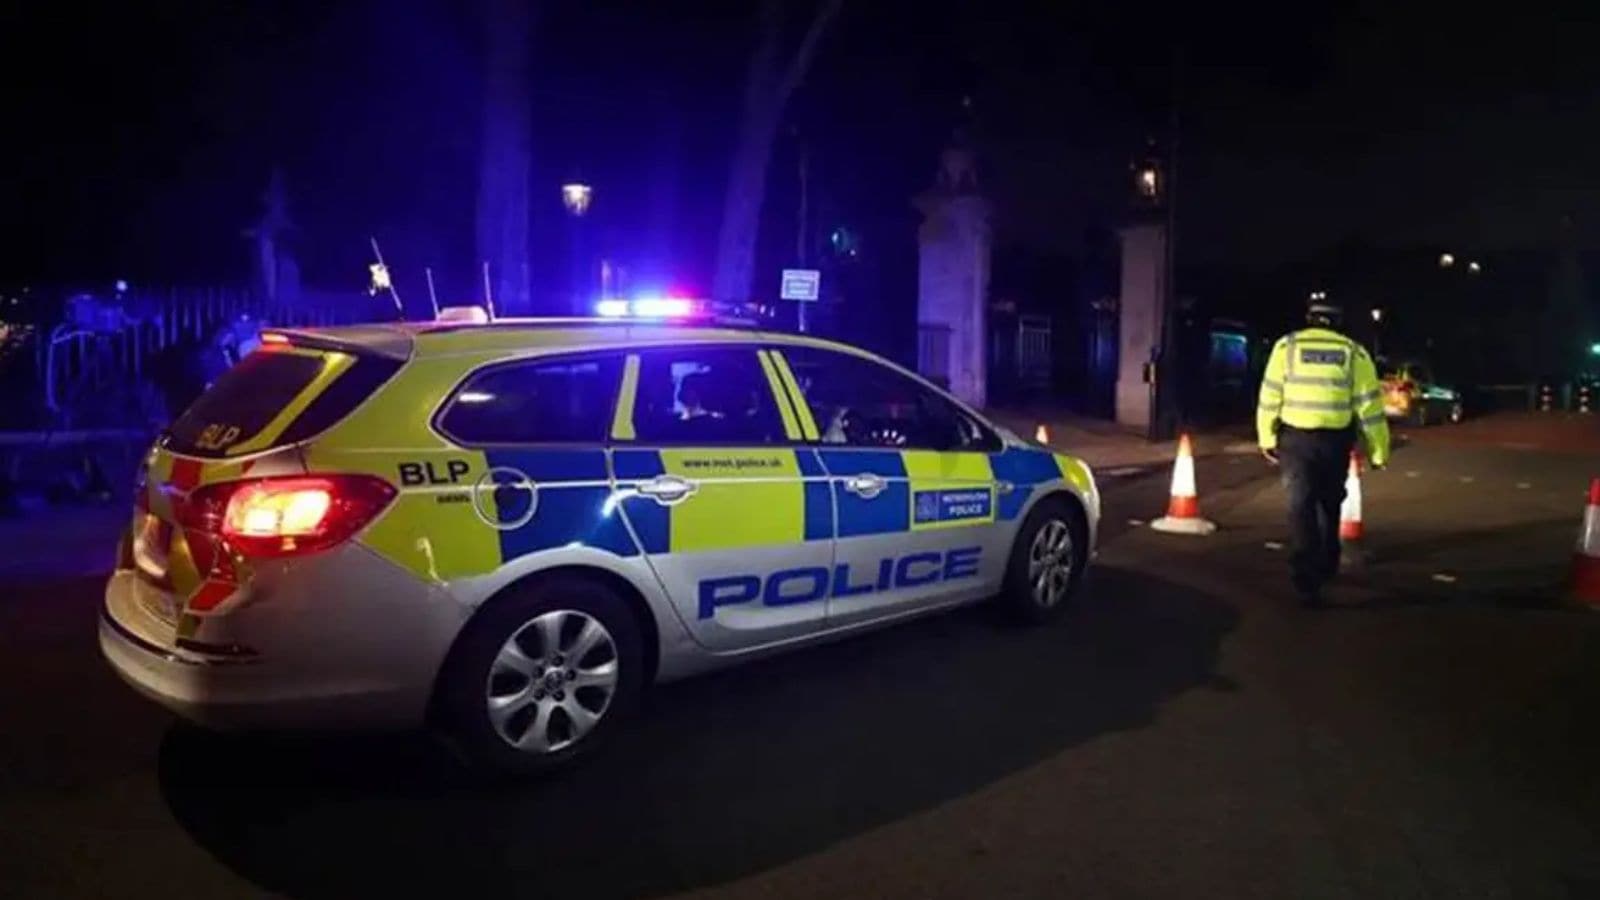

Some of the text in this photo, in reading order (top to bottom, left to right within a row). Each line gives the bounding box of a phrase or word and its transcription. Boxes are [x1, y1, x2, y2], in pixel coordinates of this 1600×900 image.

[195, 423, 240, 449] BLP
[398, 460, 469, 486] BLP
[949, 504, 983, 516] POLICE
[698, 546, 982, 620] POLICE
